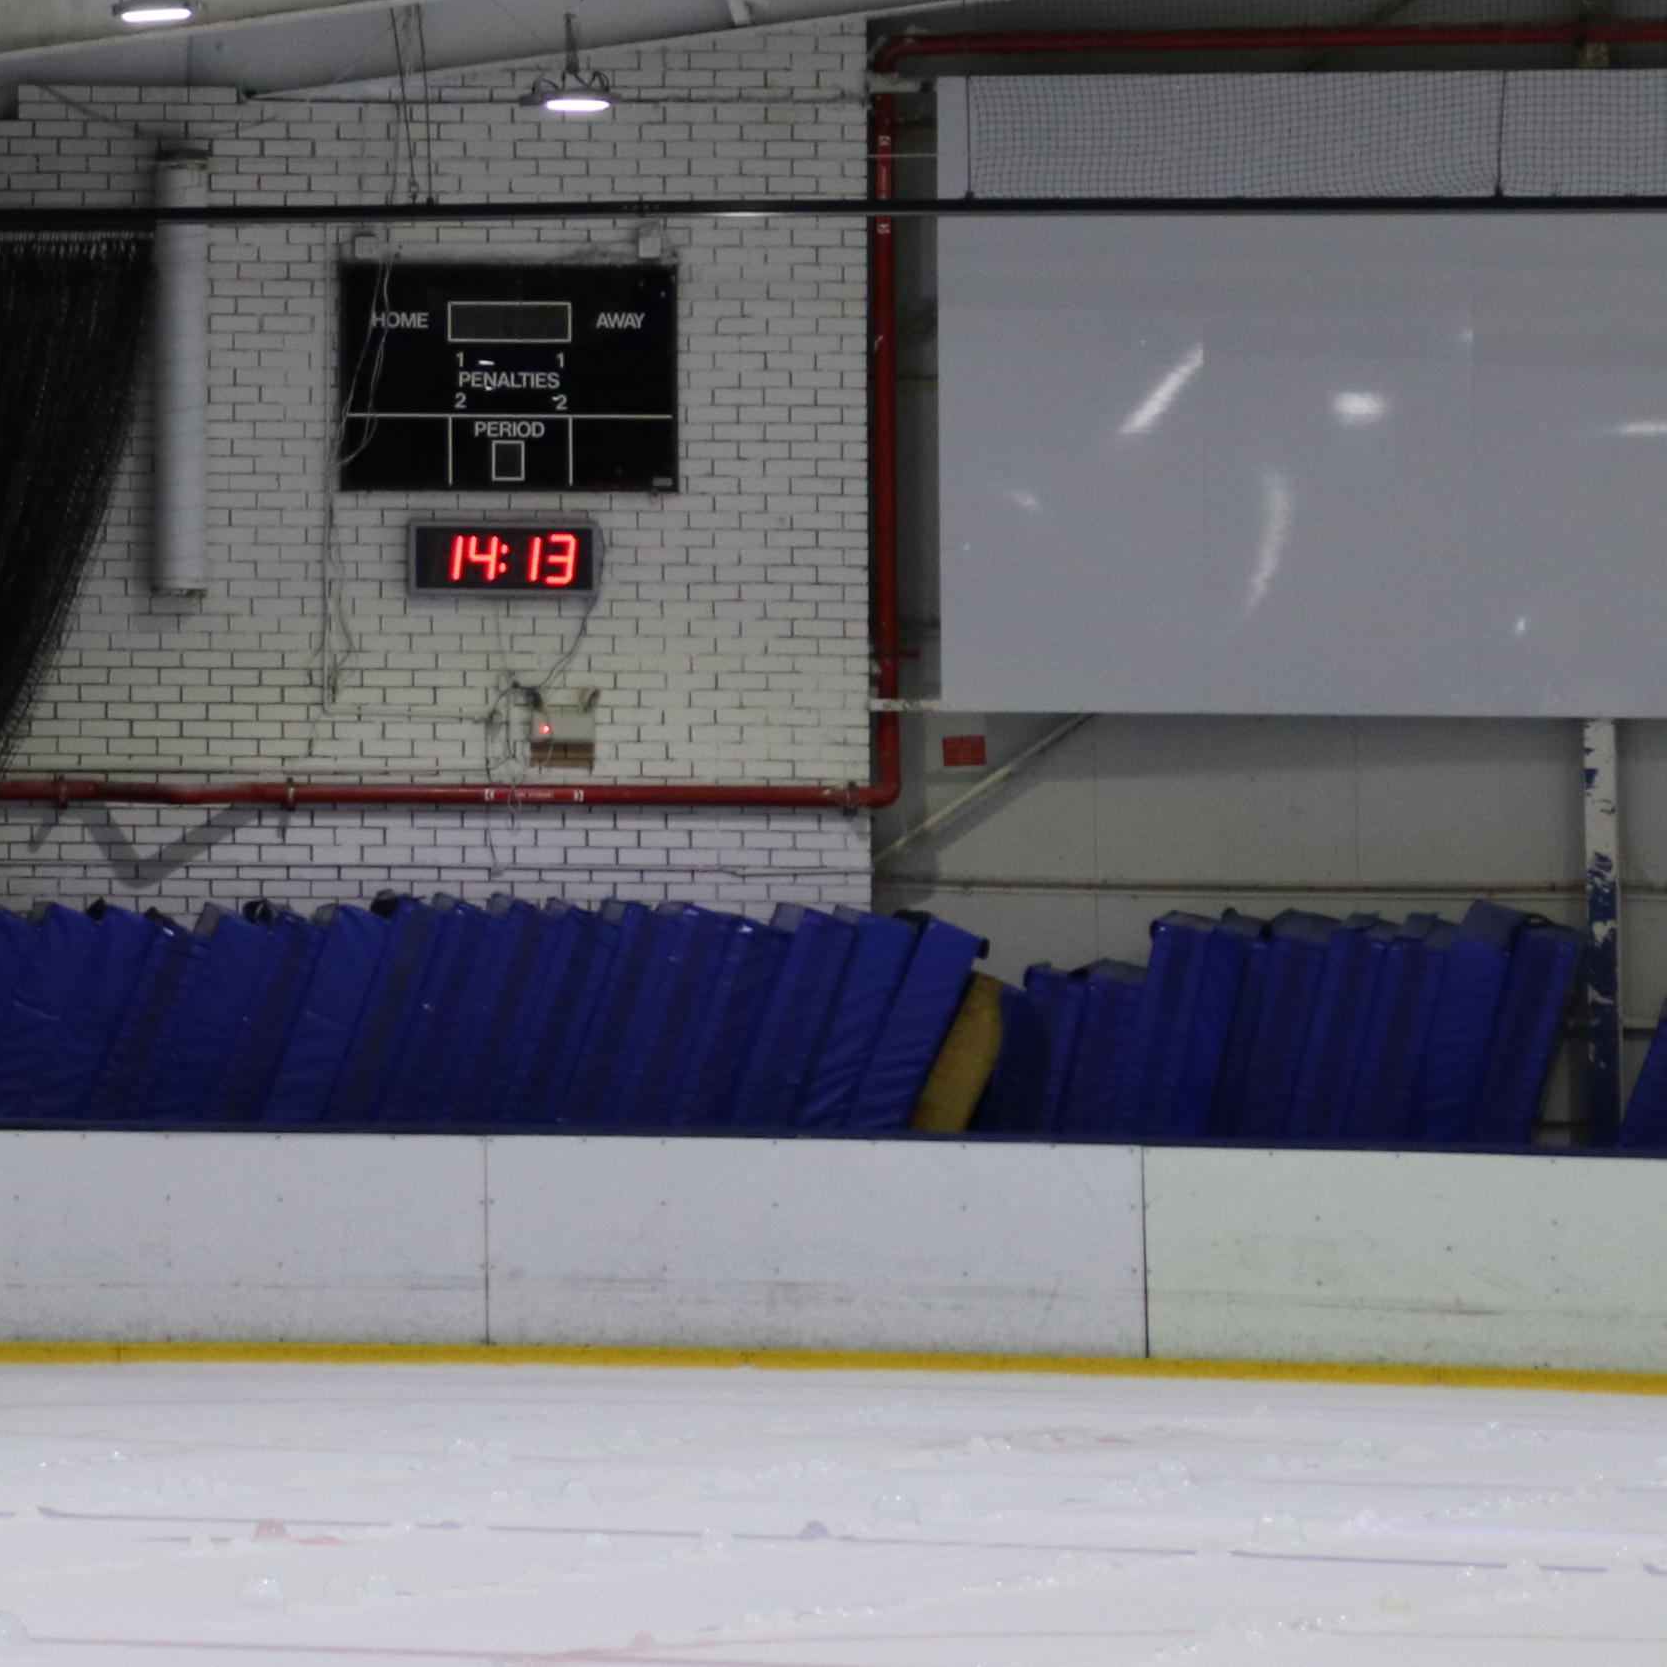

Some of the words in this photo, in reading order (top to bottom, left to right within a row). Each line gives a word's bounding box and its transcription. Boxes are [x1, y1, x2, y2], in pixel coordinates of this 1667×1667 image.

[372, 311, 429, 329] HOME
[596, 312, 645, 329] AWAY
[456, 351, 465, 368] 1
[556, 352, 565, 369] 1
[458, 370, 560, 390] PENALTIES
[454, 392, 467, 409] 2
[555, 395, 568, 411] 2
[473, 421, 546, 438] PERIOD
[450, 533, 579, 586] 14:13
